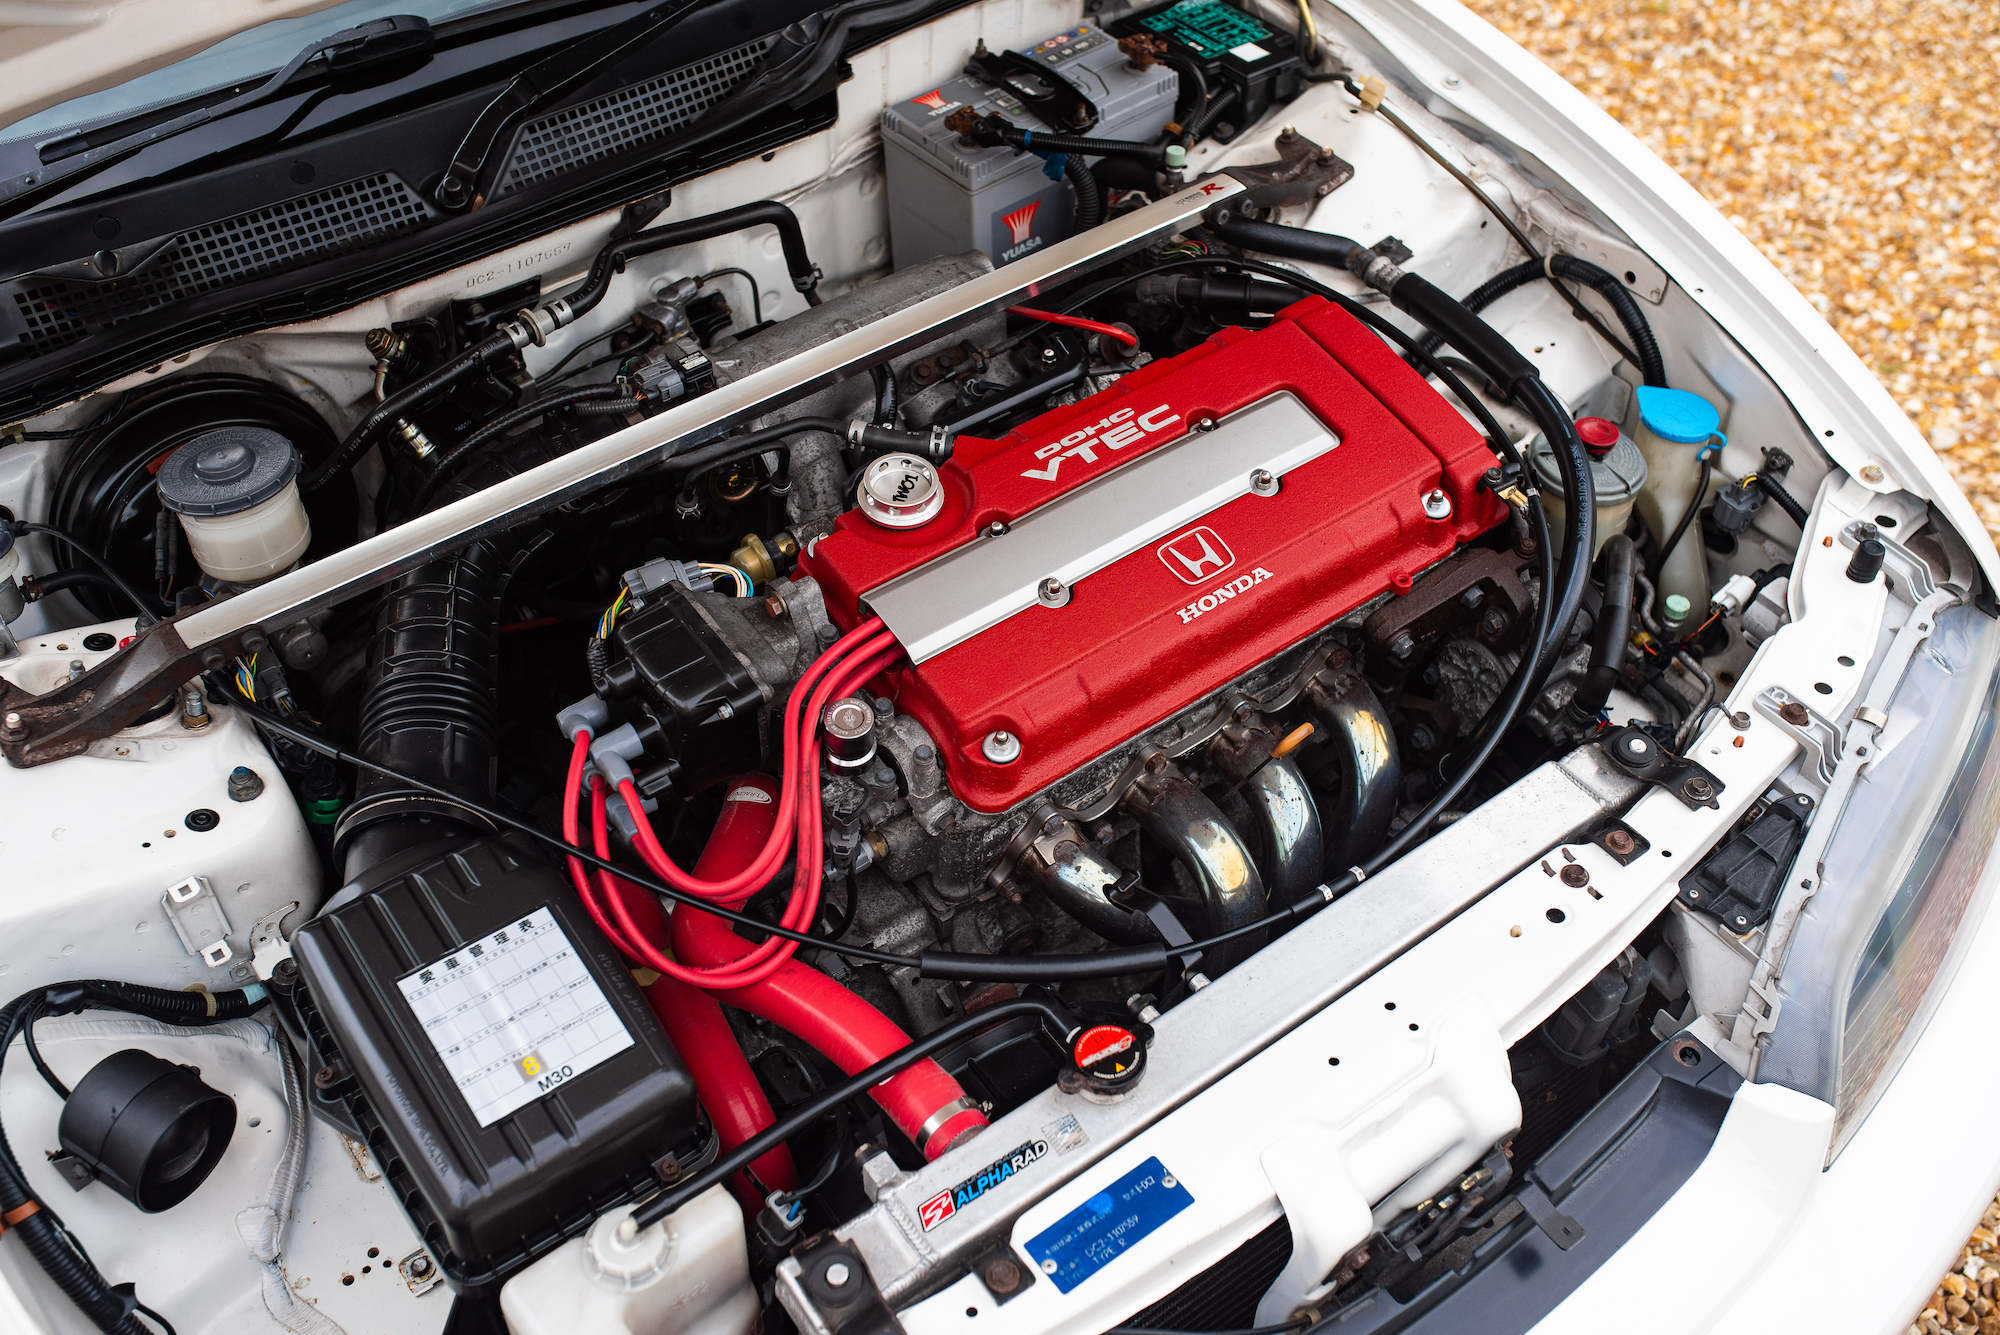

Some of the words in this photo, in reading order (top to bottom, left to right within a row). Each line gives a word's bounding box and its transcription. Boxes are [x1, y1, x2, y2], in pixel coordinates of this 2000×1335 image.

[927, 100, 962, 117] YUASA
[1001, 236, 1042, 261] YUASA
[1020, 404, 1181, 481] VTEC
[1034, 407, 1135, 460] DOHC
[1176, 567, 1274, 624] HONDA
[419, 919, 534, 985] 愛車管理表
[522, 1056, 541, 1076] 8
[537, 1065, 573, 1093] M30
[994, 1141, 1032, 1166] RACING
[956, 1140, 1048, 1209] ALPHARAD
